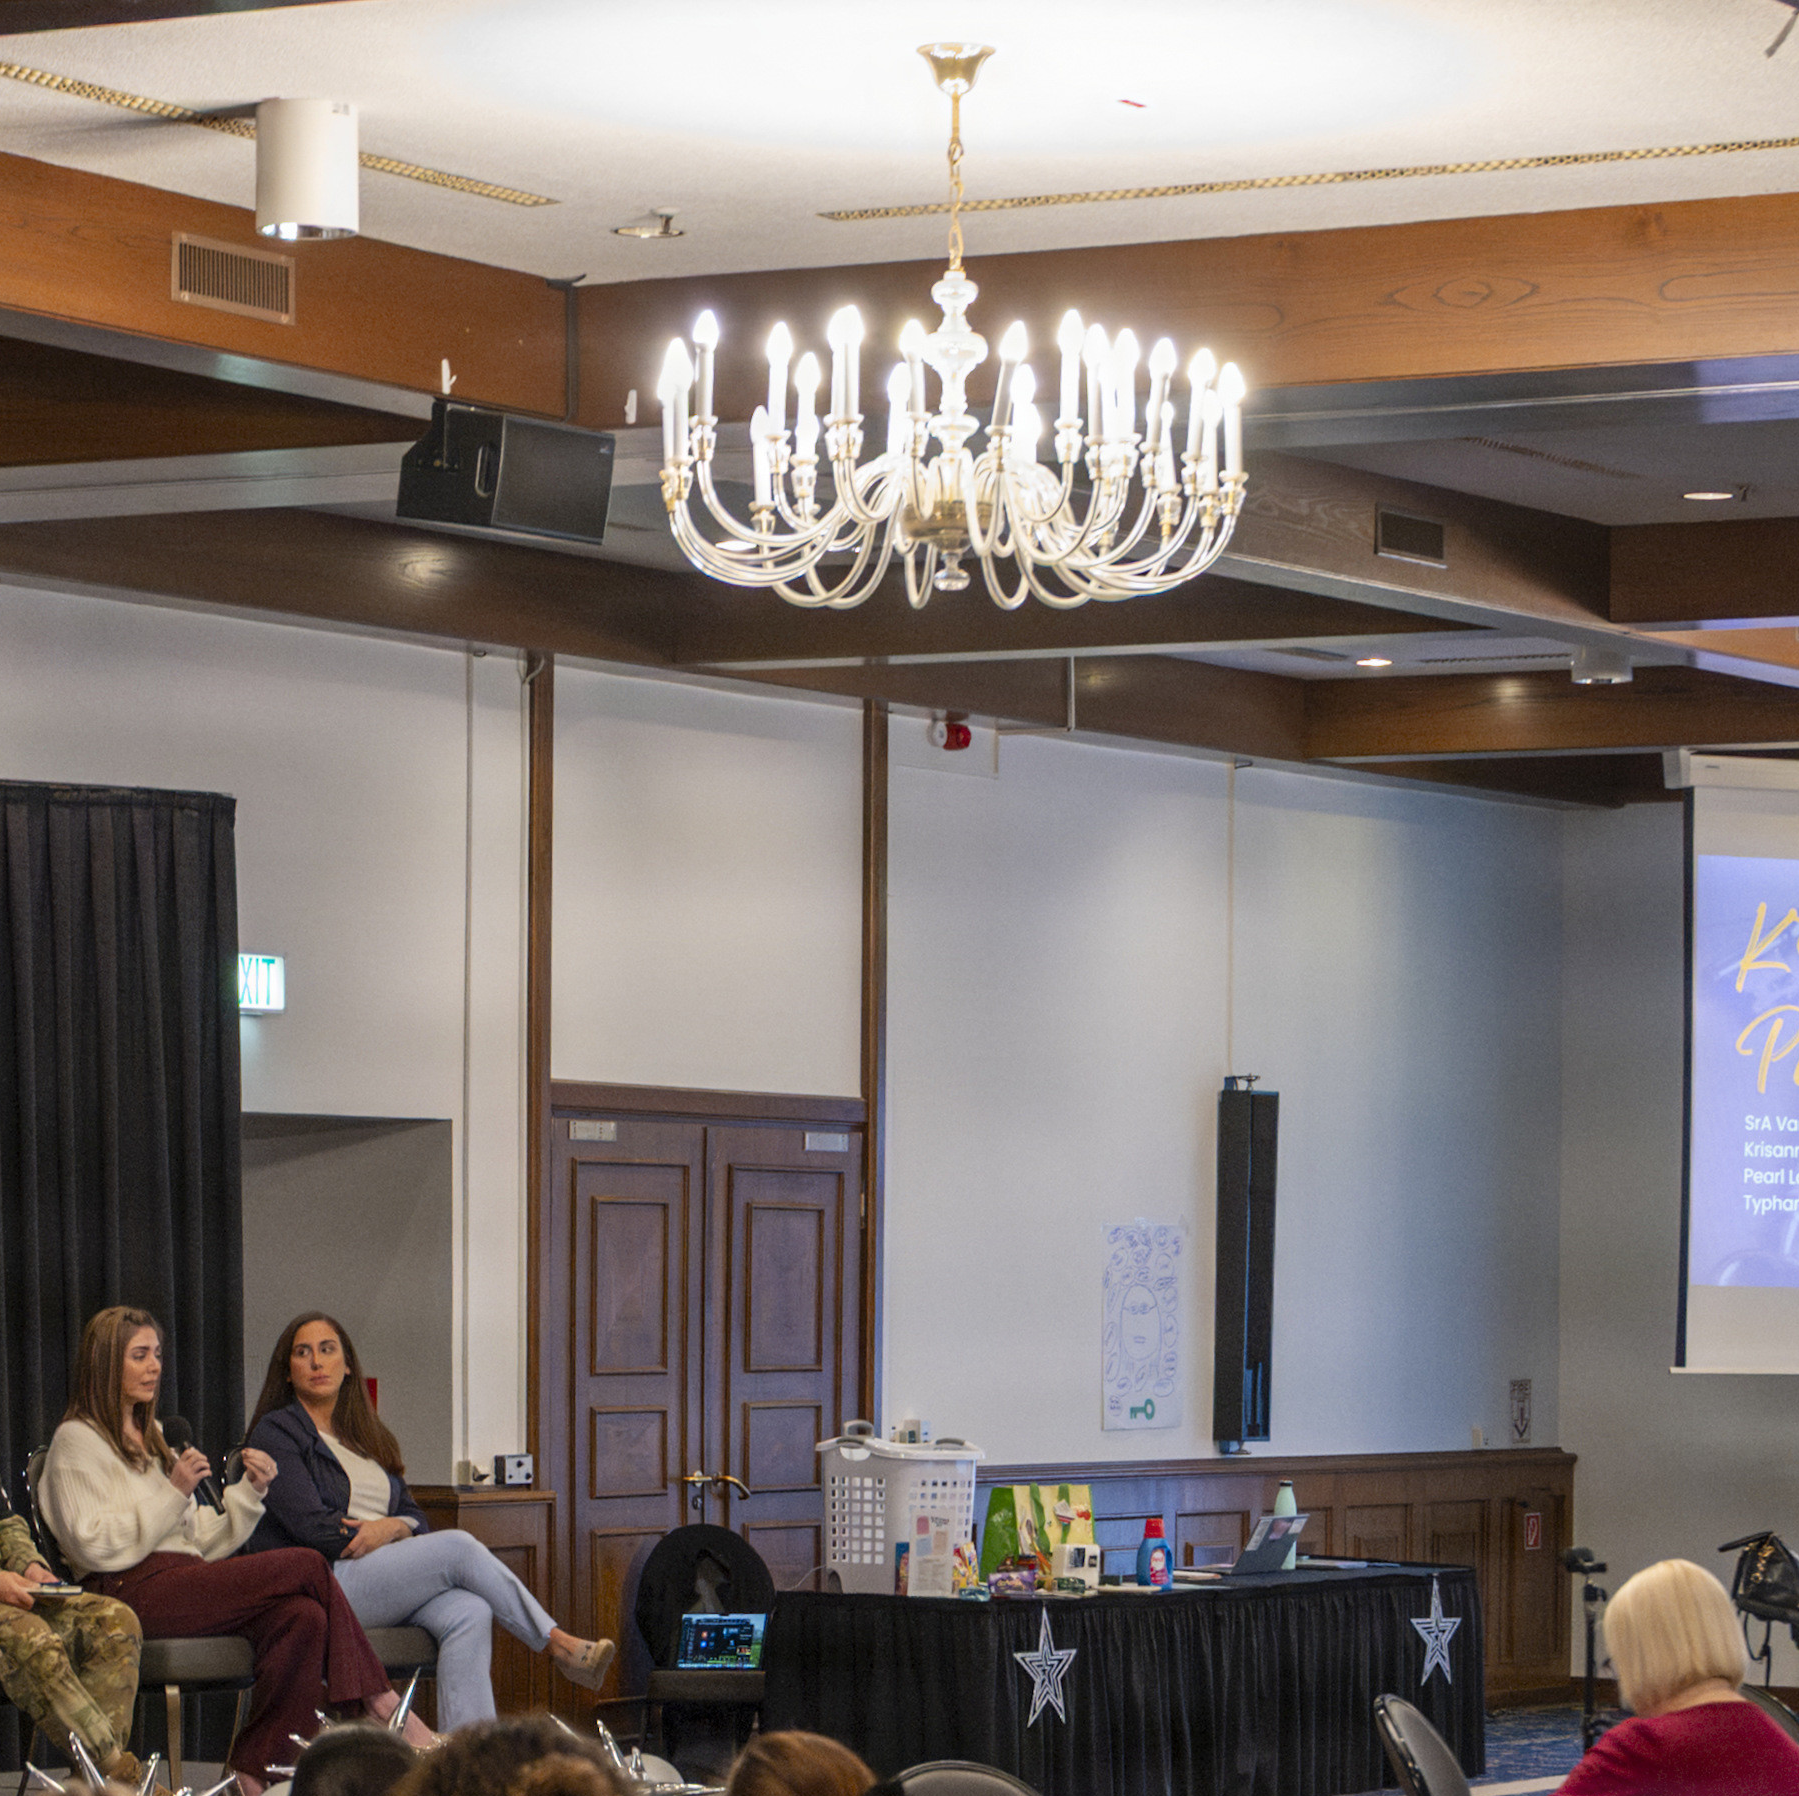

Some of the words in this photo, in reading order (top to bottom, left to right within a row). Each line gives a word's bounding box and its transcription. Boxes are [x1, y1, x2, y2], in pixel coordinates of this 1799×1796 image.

[239, 957, 275, 1005] XIT
[1744, 1115, 1772, 1131] SrA
[1743, 1168, 1785, 1185] Pearl
